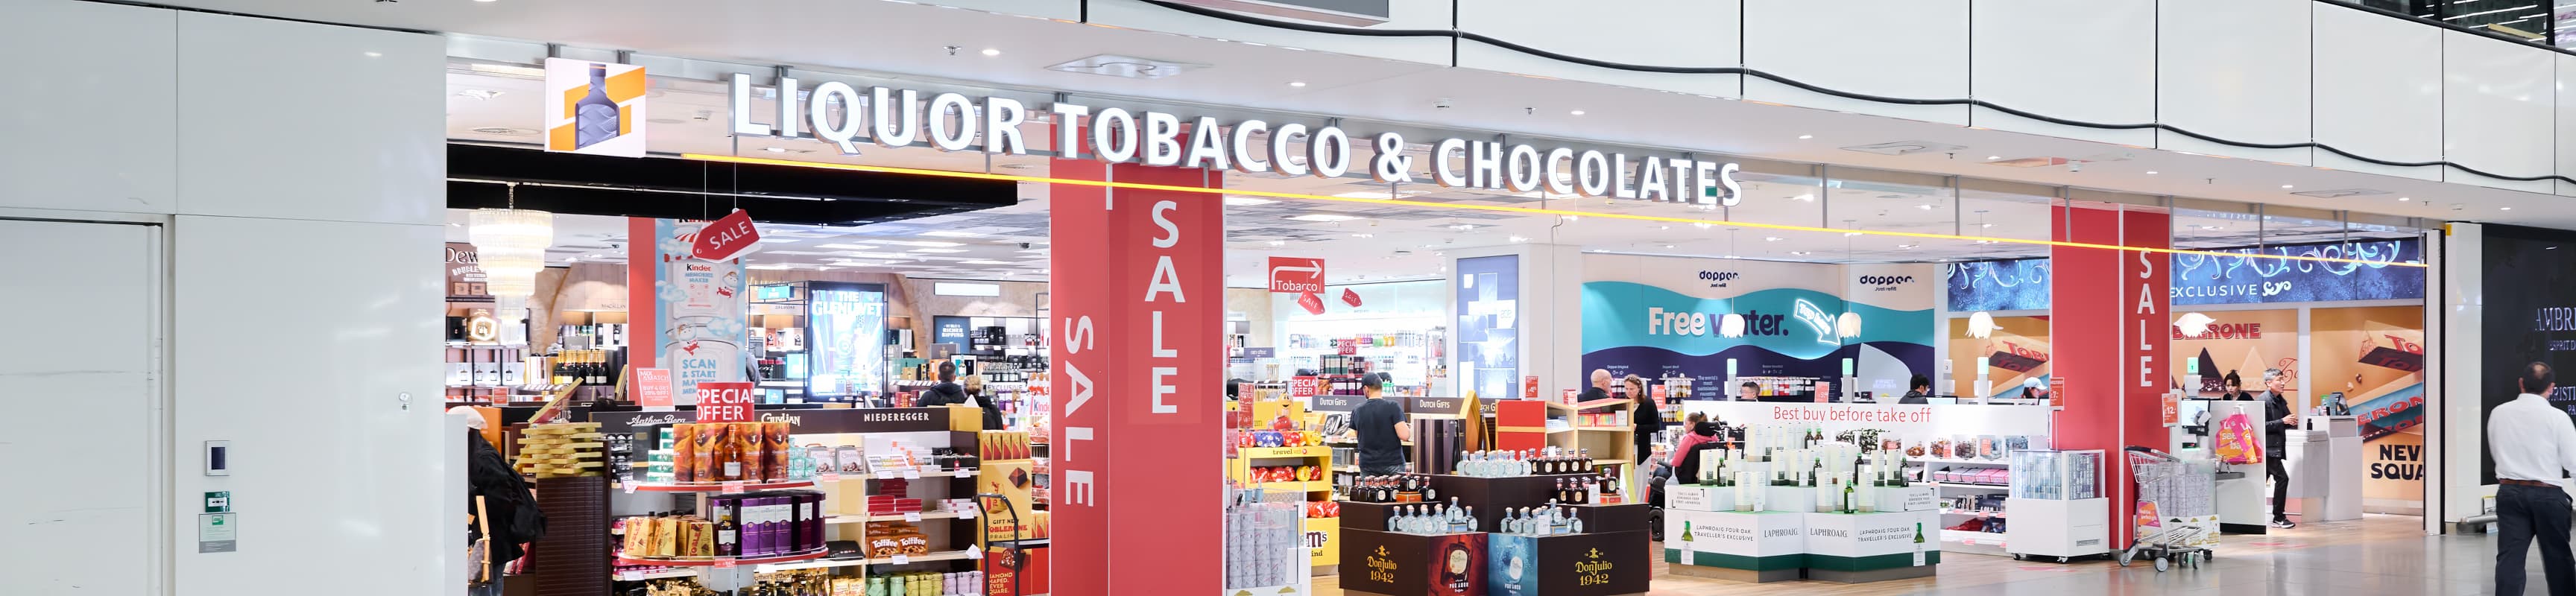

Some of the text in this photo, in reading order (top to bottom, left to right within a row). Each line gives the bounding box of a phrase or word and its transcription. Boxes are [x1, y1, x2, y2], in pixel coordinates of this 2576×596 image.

[728, 73, 1743, 207] LIQUOR TOBACCO & CHOCOLATES
[710, 221, 750, 250] SALE
[686, 263, 712, 272] Kinder
[1275, 280, 1318, 292] Tobacco
[2170, 284, 2258, 298] EXCLUSIVE
[839, 291, 859, 302] THE
[812, 301, 884, 317] GLENLIVET
[1144, 200, 1186, 413] SALE
[1649, 306, 1789, 336] Free wter.
[2136, 247, 2156, 387] SALE
[2172, 323, 2261, 340] BRONE
[682, 358, 716, 370] SCAN
[697, 388, 754, 404] SPECIAL
[1319, 397, 1334, 406] DUTCH
[1420, 399, 1450, 408] DUTCH GIFTS
[697, 405, 744, 420] OFFER
[864, 412, 929, 422] NIEDEREGGER
[1064, 315, 1094, 507] SALE
[1774, 406, 1932, 423] Best buy before take off
[988, 524, 1028, 533] OBLERNE
[1694, 531, 1726, 539] TRAVELLER'S
[1764, 527, 1798, 538] LAPHROAIG
[1810, 527, 1848, 538] LAPHROAIG
[871, 539, 898, 548] Toffifee
[899, 536, 926, 546] Toffifee
[1370, 570, 1394, 583] 1942
[1579, 573, 1609, 586] 1942
